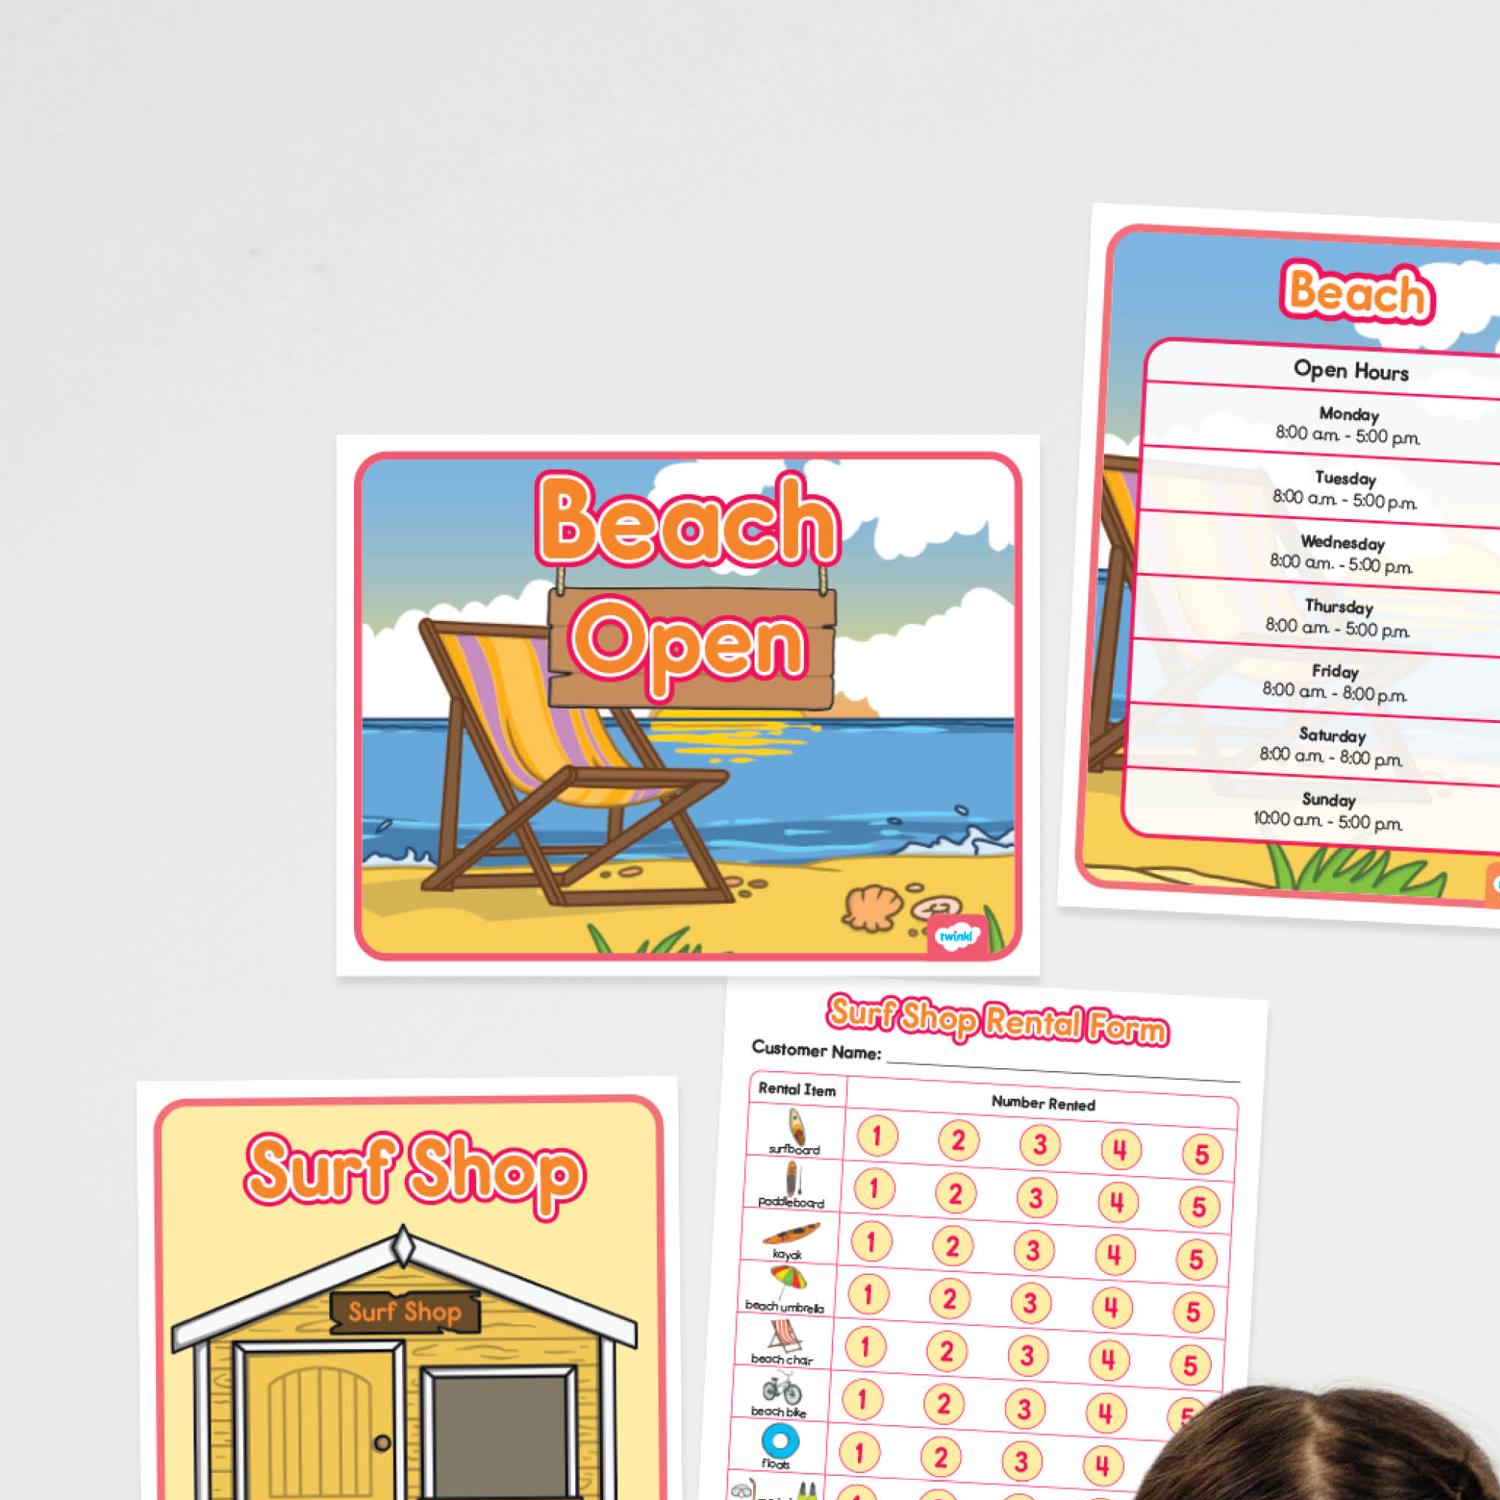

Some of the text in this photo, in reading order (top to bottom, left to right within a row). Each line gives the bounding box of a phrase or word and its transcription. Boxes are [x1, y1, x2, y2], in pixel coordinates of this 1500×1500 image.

[1282, 260, 1436, 324] Beach
[1293, 358, 1410, 383] Open Hours
[1319, 405, 1380, 427] Monday
[1315, 469, 1377, 491] Tuesday
[535, 469, 841, 568] Beach
[1300, 533, 1386, 555] Wednesday
[1269, 552, 1301, 569] 8:00
[1348, 556, 1382, 573] 5:00
[1305, 597, 1374, 619] Thursday
[568, 593, 808, 704] Open
[1312, 663, 1360, 683] Friday
[1298, 725, 1367, 747] Saturday
[1301, 791, 1357, 812] Sunday
[939, 927, 973, 944] twinkl
[825, 991, 1170, 1048] Surf Shop Rental Form
[751, 1038, 882, 1061] Customer Name:
[758, 1081, 837, 1097] Rental Item
[991, 1094, 1096, 1112] Number Rented
[768, 1143, 821, 1156] surfboard
[873, 1124, 1210, 1166] 1 2 3 4 5
[244, 1129, 588, 1224] Surf Shop
[758, 1196, 825, 1210] paddleboard
[772, 1248, 802, 1262] kayak
[347, 1299, 463, 1327] Surf Shop
[745, 1299, 825, 1314] beach umbrella
[751, 1353, 814, 1367] beach chair
[751, 1405, 807, 1419] beach bike
[761, 1457, 791, 1470] floats
